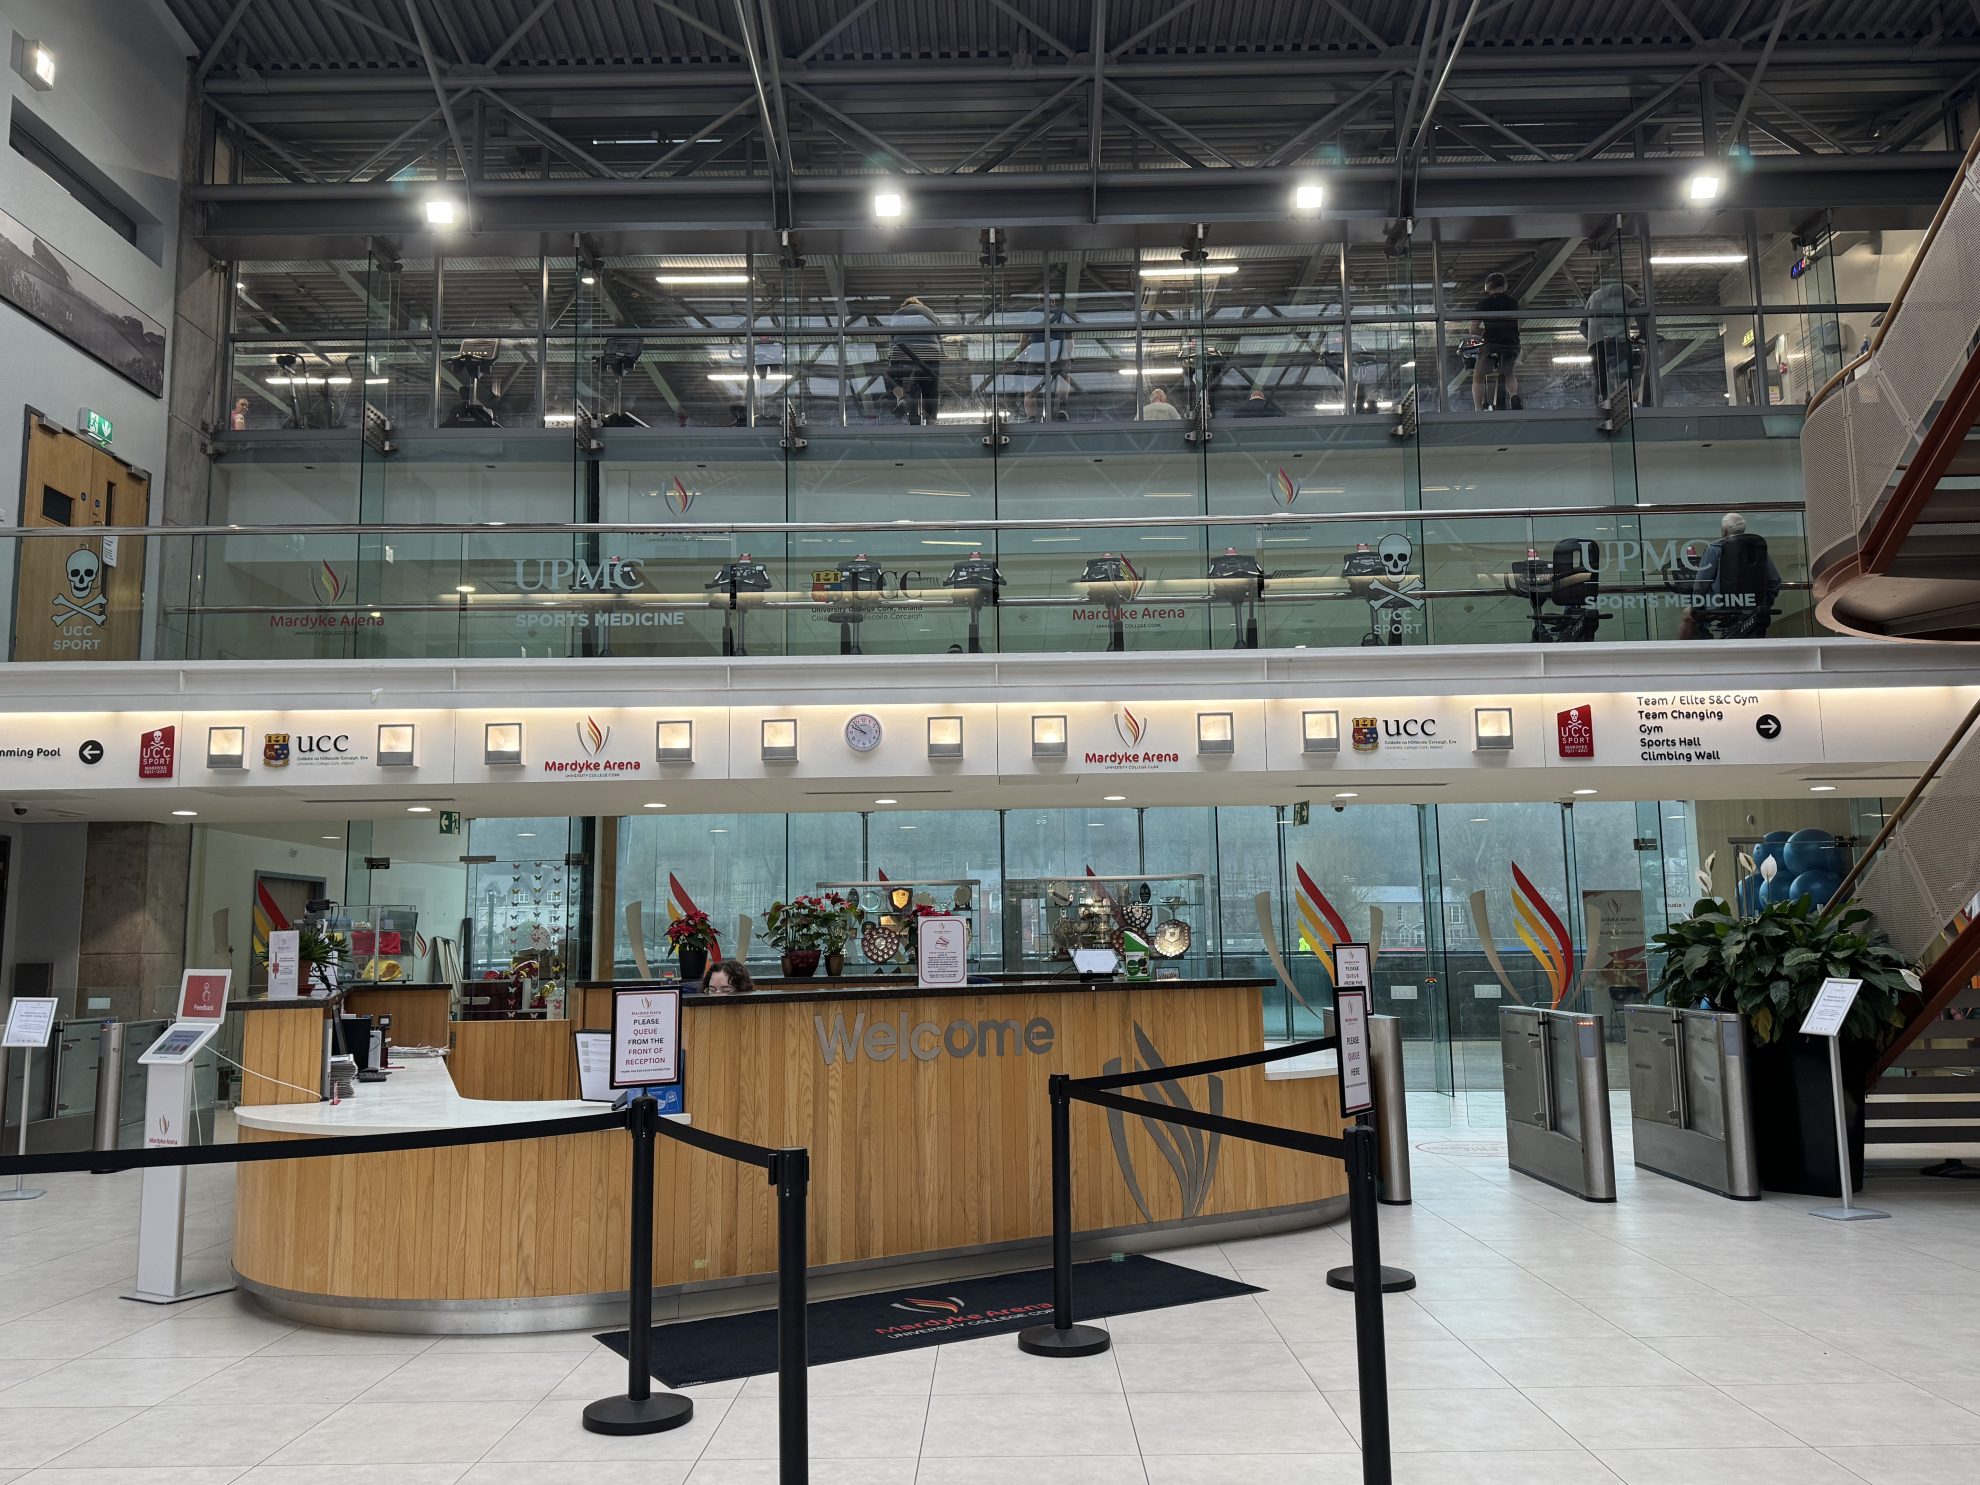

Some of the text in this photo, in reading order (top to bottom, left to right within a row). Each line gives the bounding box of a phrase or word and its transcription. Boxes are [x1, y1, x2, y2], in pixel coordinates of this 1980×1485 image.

[1578, 539, 1713, 573] UPMC
[513, 558, 644, 591] UPMC
[1584, 593, 1757, 609] SPORTS MEDICINE
[515, 611, 684, 628] SPORTS MEDICINE
[1072, 606, 1185, 622] Mardyke Arena
[1382, 610, 1412, 621] UCC
[270, 614, 385, 629] Mardyke Arena
[63, 625, 93, 637] UCC
[1373, 624, 1421, 634] SPORT
[53, 639, 101, 650] SPORT
[1637, 696, 1668, 706] Team
[1680, 695, 1706, 705] Elite
[1709, 694, 1731, 704] S&C
[1733, 694, 1759, 706] Gym
[1638, 709, 1724, 721] Team Changing
[1561, 726, 1590, 737] UCC
[1639, 724, 1663, 735] Gym
[1640, 737, 1701, 748] Sports Hall
[37, 747, 61, 757] Pool
[143, 747, 171, 758] UCC
[1641, 750, 1720, 762] Climbing Wall
[1085, 752, 1179, 765] Mardyke Arena
[544, 760, 641, 773] Mardyke Arena
[193, 1003, 214, 1011] Feedback
[633, 1028, 658, 1036] QUEUE
[628, 1038, 649, 1046] FROM
[813, 1011, 1055, 1066] Welcome
[1346, 1036, 1360, 1045] PLEASE
[625, 1057, 666, 1065] RECEPTION
[1347, 1052, 1360, 1062] QUEUE
[875, 1303, 1053, 1334] Mardyke Arena
[888, 1308, 1055, 1339] UNIVERSITY COLLEGE COR
